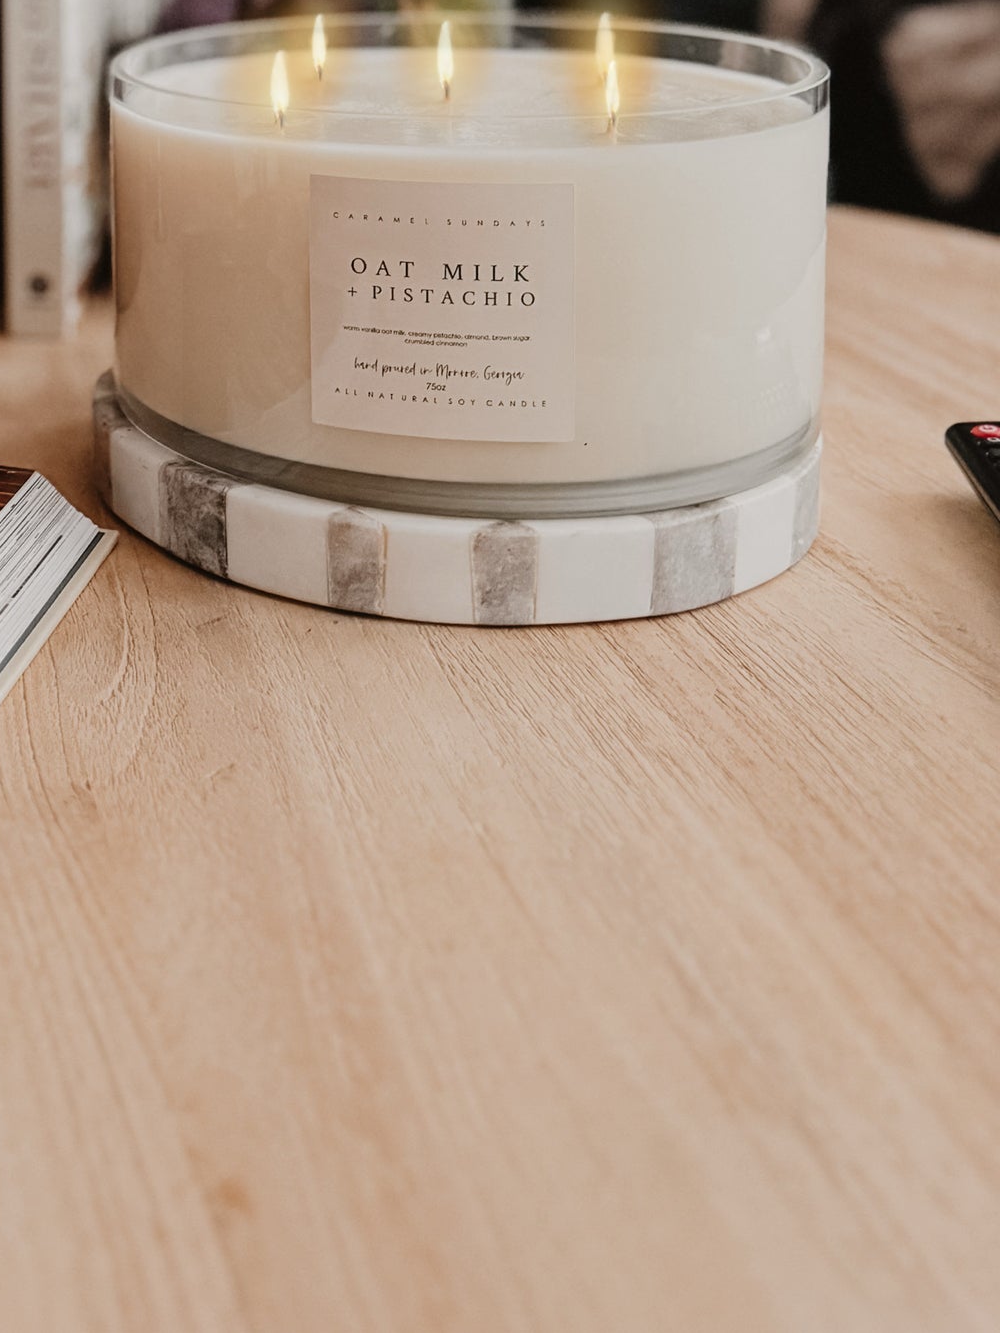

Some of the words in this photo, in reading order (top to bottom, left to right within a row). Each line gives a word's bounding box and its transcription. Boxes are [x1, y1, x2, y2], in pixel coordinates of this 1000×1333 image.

[332, 211, 429, 225] CARAMEL
[446, 218, 546, 228] SUNDAYS
[350, 257, 416, 279] OAT
[441, 262, 531, 283] MILK
[347, 286, 358, 298] +
[371, 284, 536, 307] PISTACHIO
[404, 338, 435, 346] crumbled
[436, 339, 468, 348] cinnamon
[408, 331, 432, 339] creamy
[353, 356, 379, 373] hand
[483, 364, 526, 386] Georgia
[425, 381, 447, 392] 75oz
[334, 387, 358, 397] ALL
[367, 391, 439, 405] NATURAL
[447, 397, 476, 407] SOY
[485, 399, 547, 408] CANDLE
